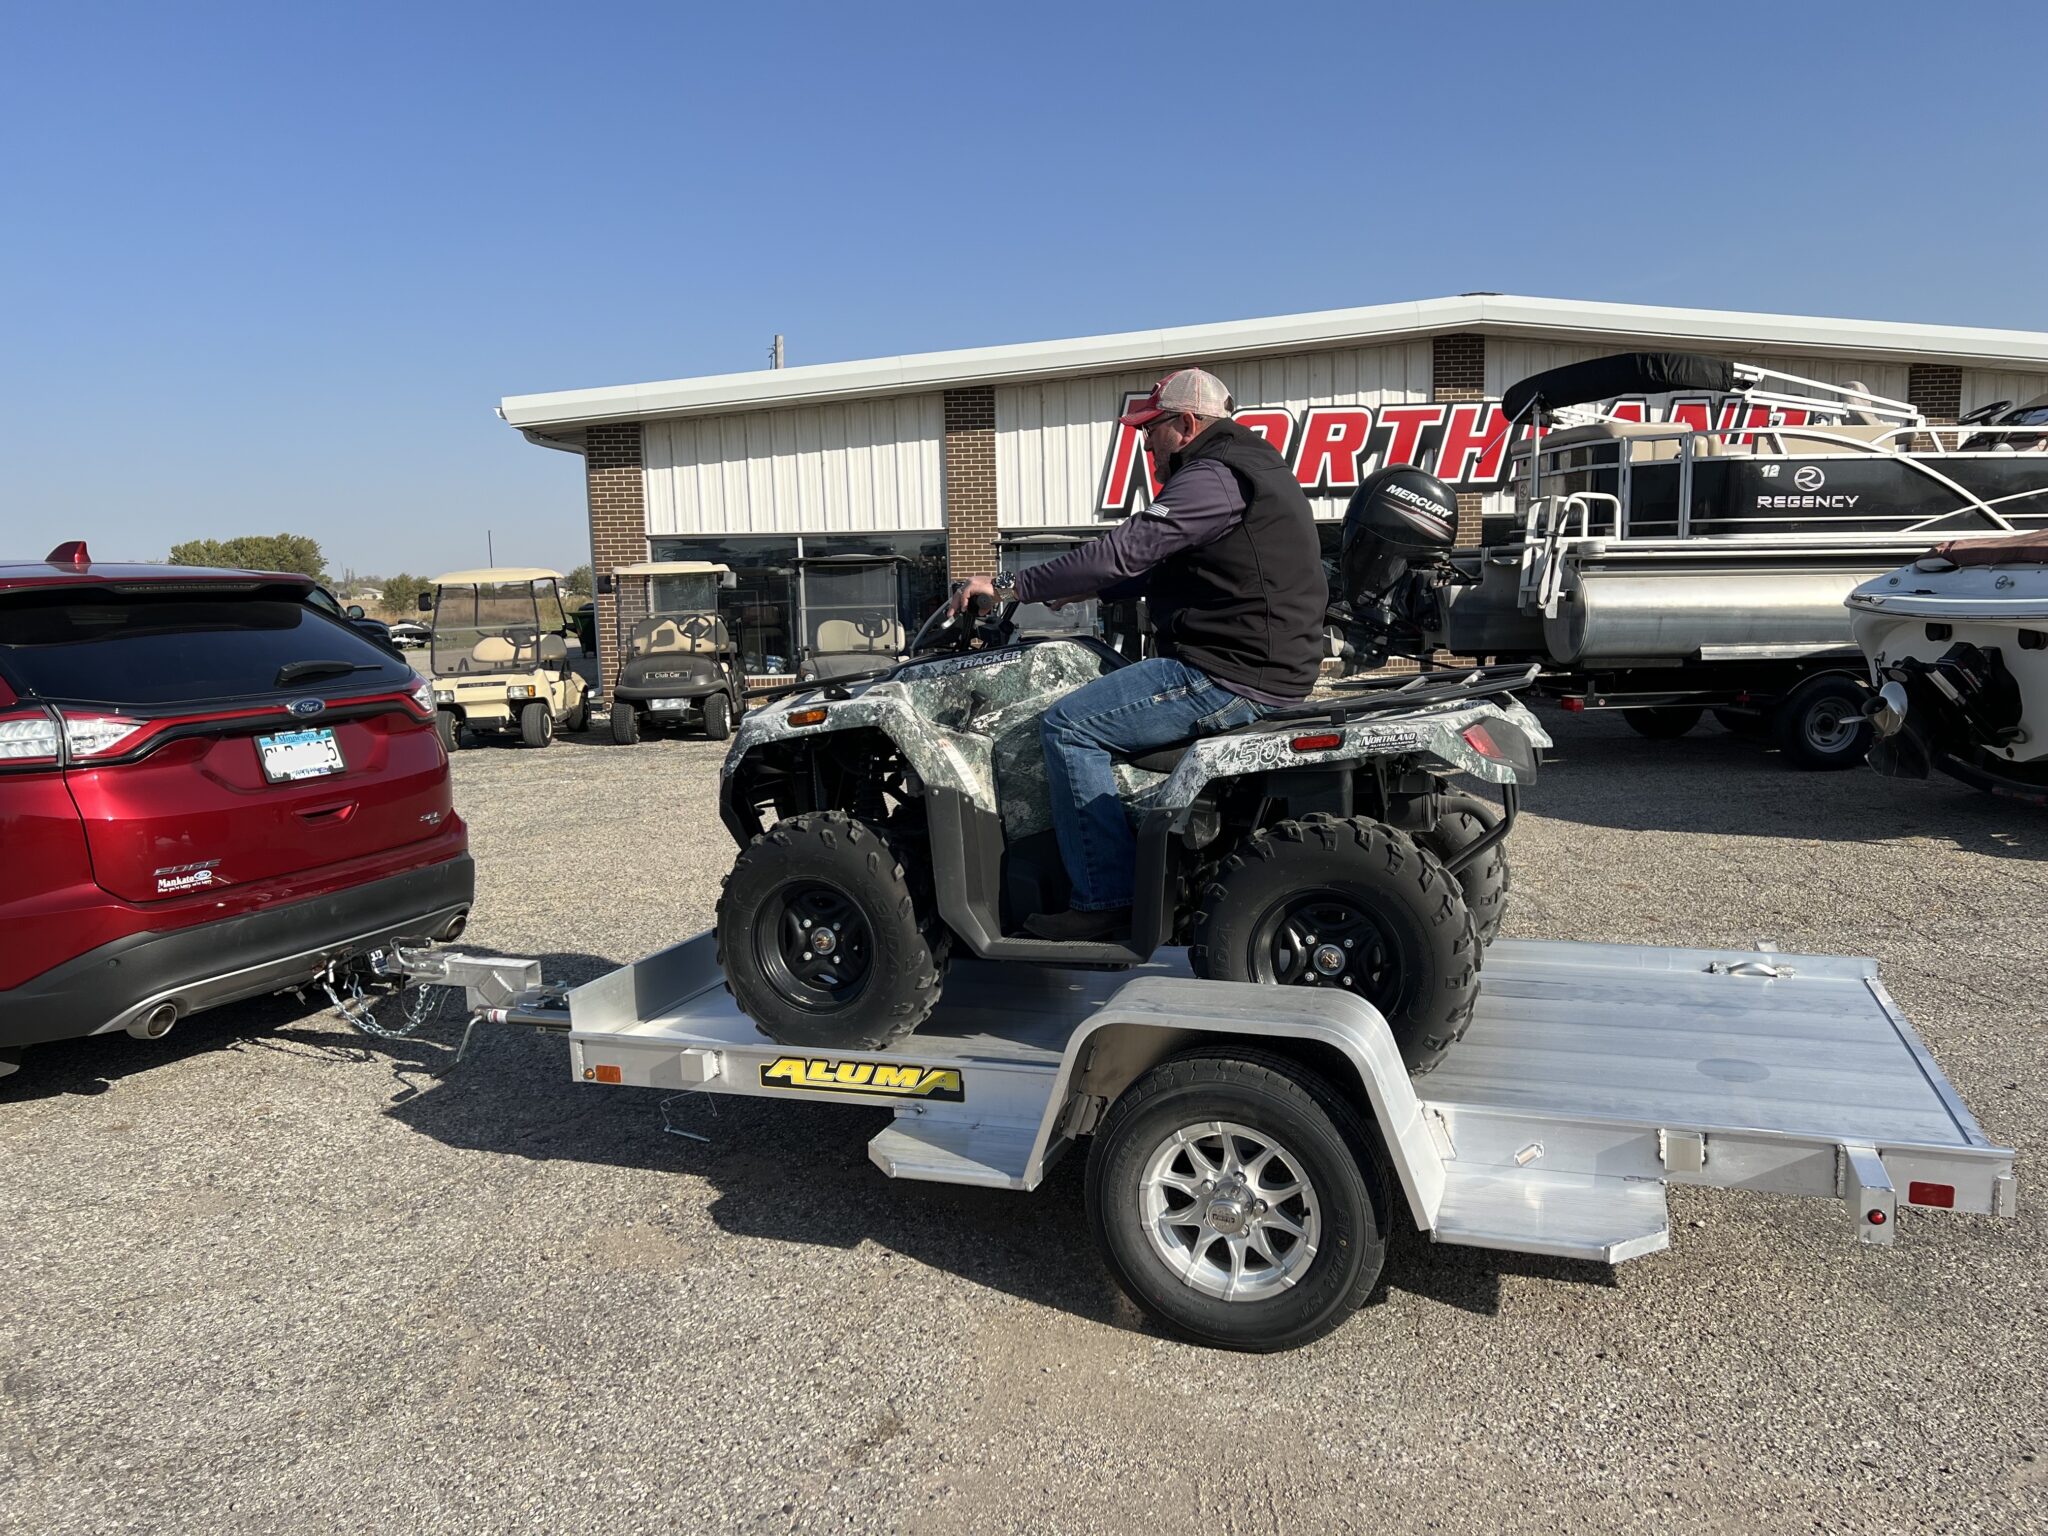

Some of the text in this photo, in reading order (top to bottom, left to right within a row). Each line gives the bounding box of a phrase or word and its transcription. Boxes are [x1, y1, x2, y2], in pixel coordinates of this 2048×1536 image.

[1100, 391, 1809, 518] NORTH
[1761, 464, 1780, 478] 12
[1385, 484, 1453, 518] MERCURY
[1757, 495, 1859, 508] REGENCY
[956, 650, 1022, 669] TRACKER
[277, 732, 315, 744] Minnesota
[1361, 732, 1416, 746] NORTHLAND
[1217, 739, 1281, 768] 450
[157, 876, 196, 889] Mankato
[765, 1058, 960, 1094] ALUMA
